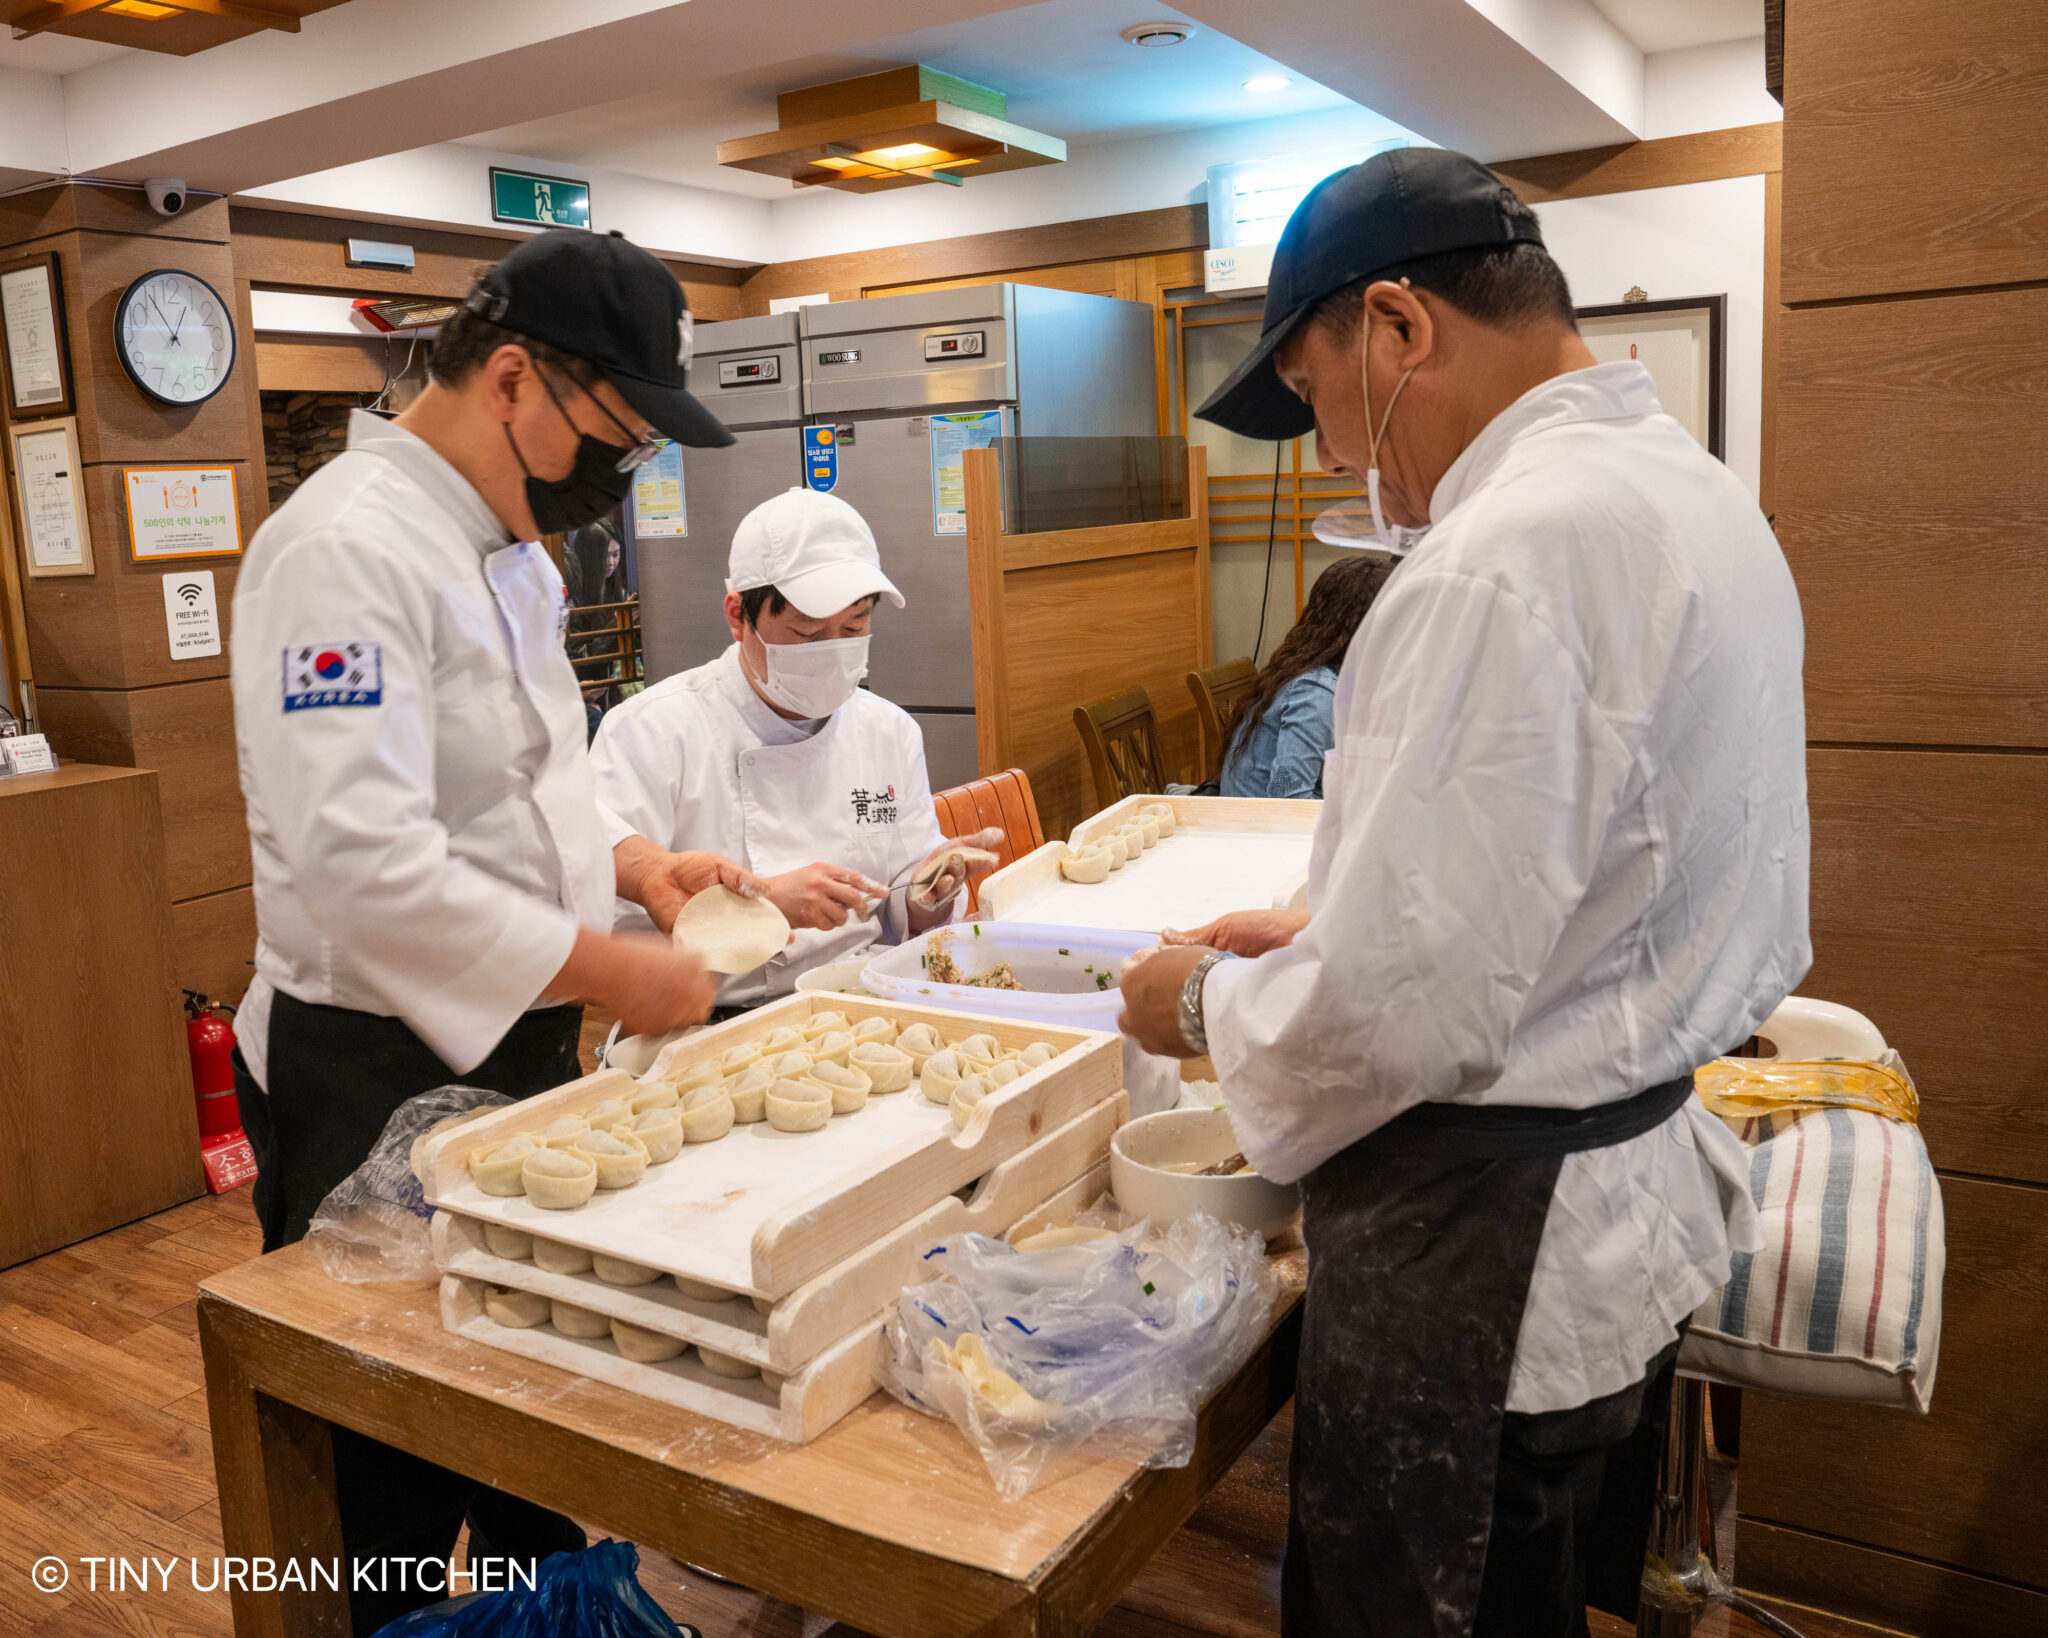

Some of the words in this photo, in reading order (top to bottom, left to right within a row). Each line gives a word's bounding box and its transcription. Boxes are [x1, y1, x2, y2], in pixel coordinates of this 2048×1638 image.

[143, 285, 157, 311] 11
[161, 278, 180, 305] 12
[188, 286, 194, 312] 1
[128, 302, 148, 329] 10
[200, 301, 214, 327] 2
[211, 326, 225, 352] 3
[132, 351, 146, 377] 8
[205, 351, 217, 376] 4
[826, 354, 841, 362] WOO
[841, 352, 858, 361] SUNG
[151, 367, 165, 393] 7
[171, 374, 185, 400] 6
[193, 366, 206, 391] 5
[143, 517, 174, 528] 500인의
[176, 611, 191, 619] FREE
